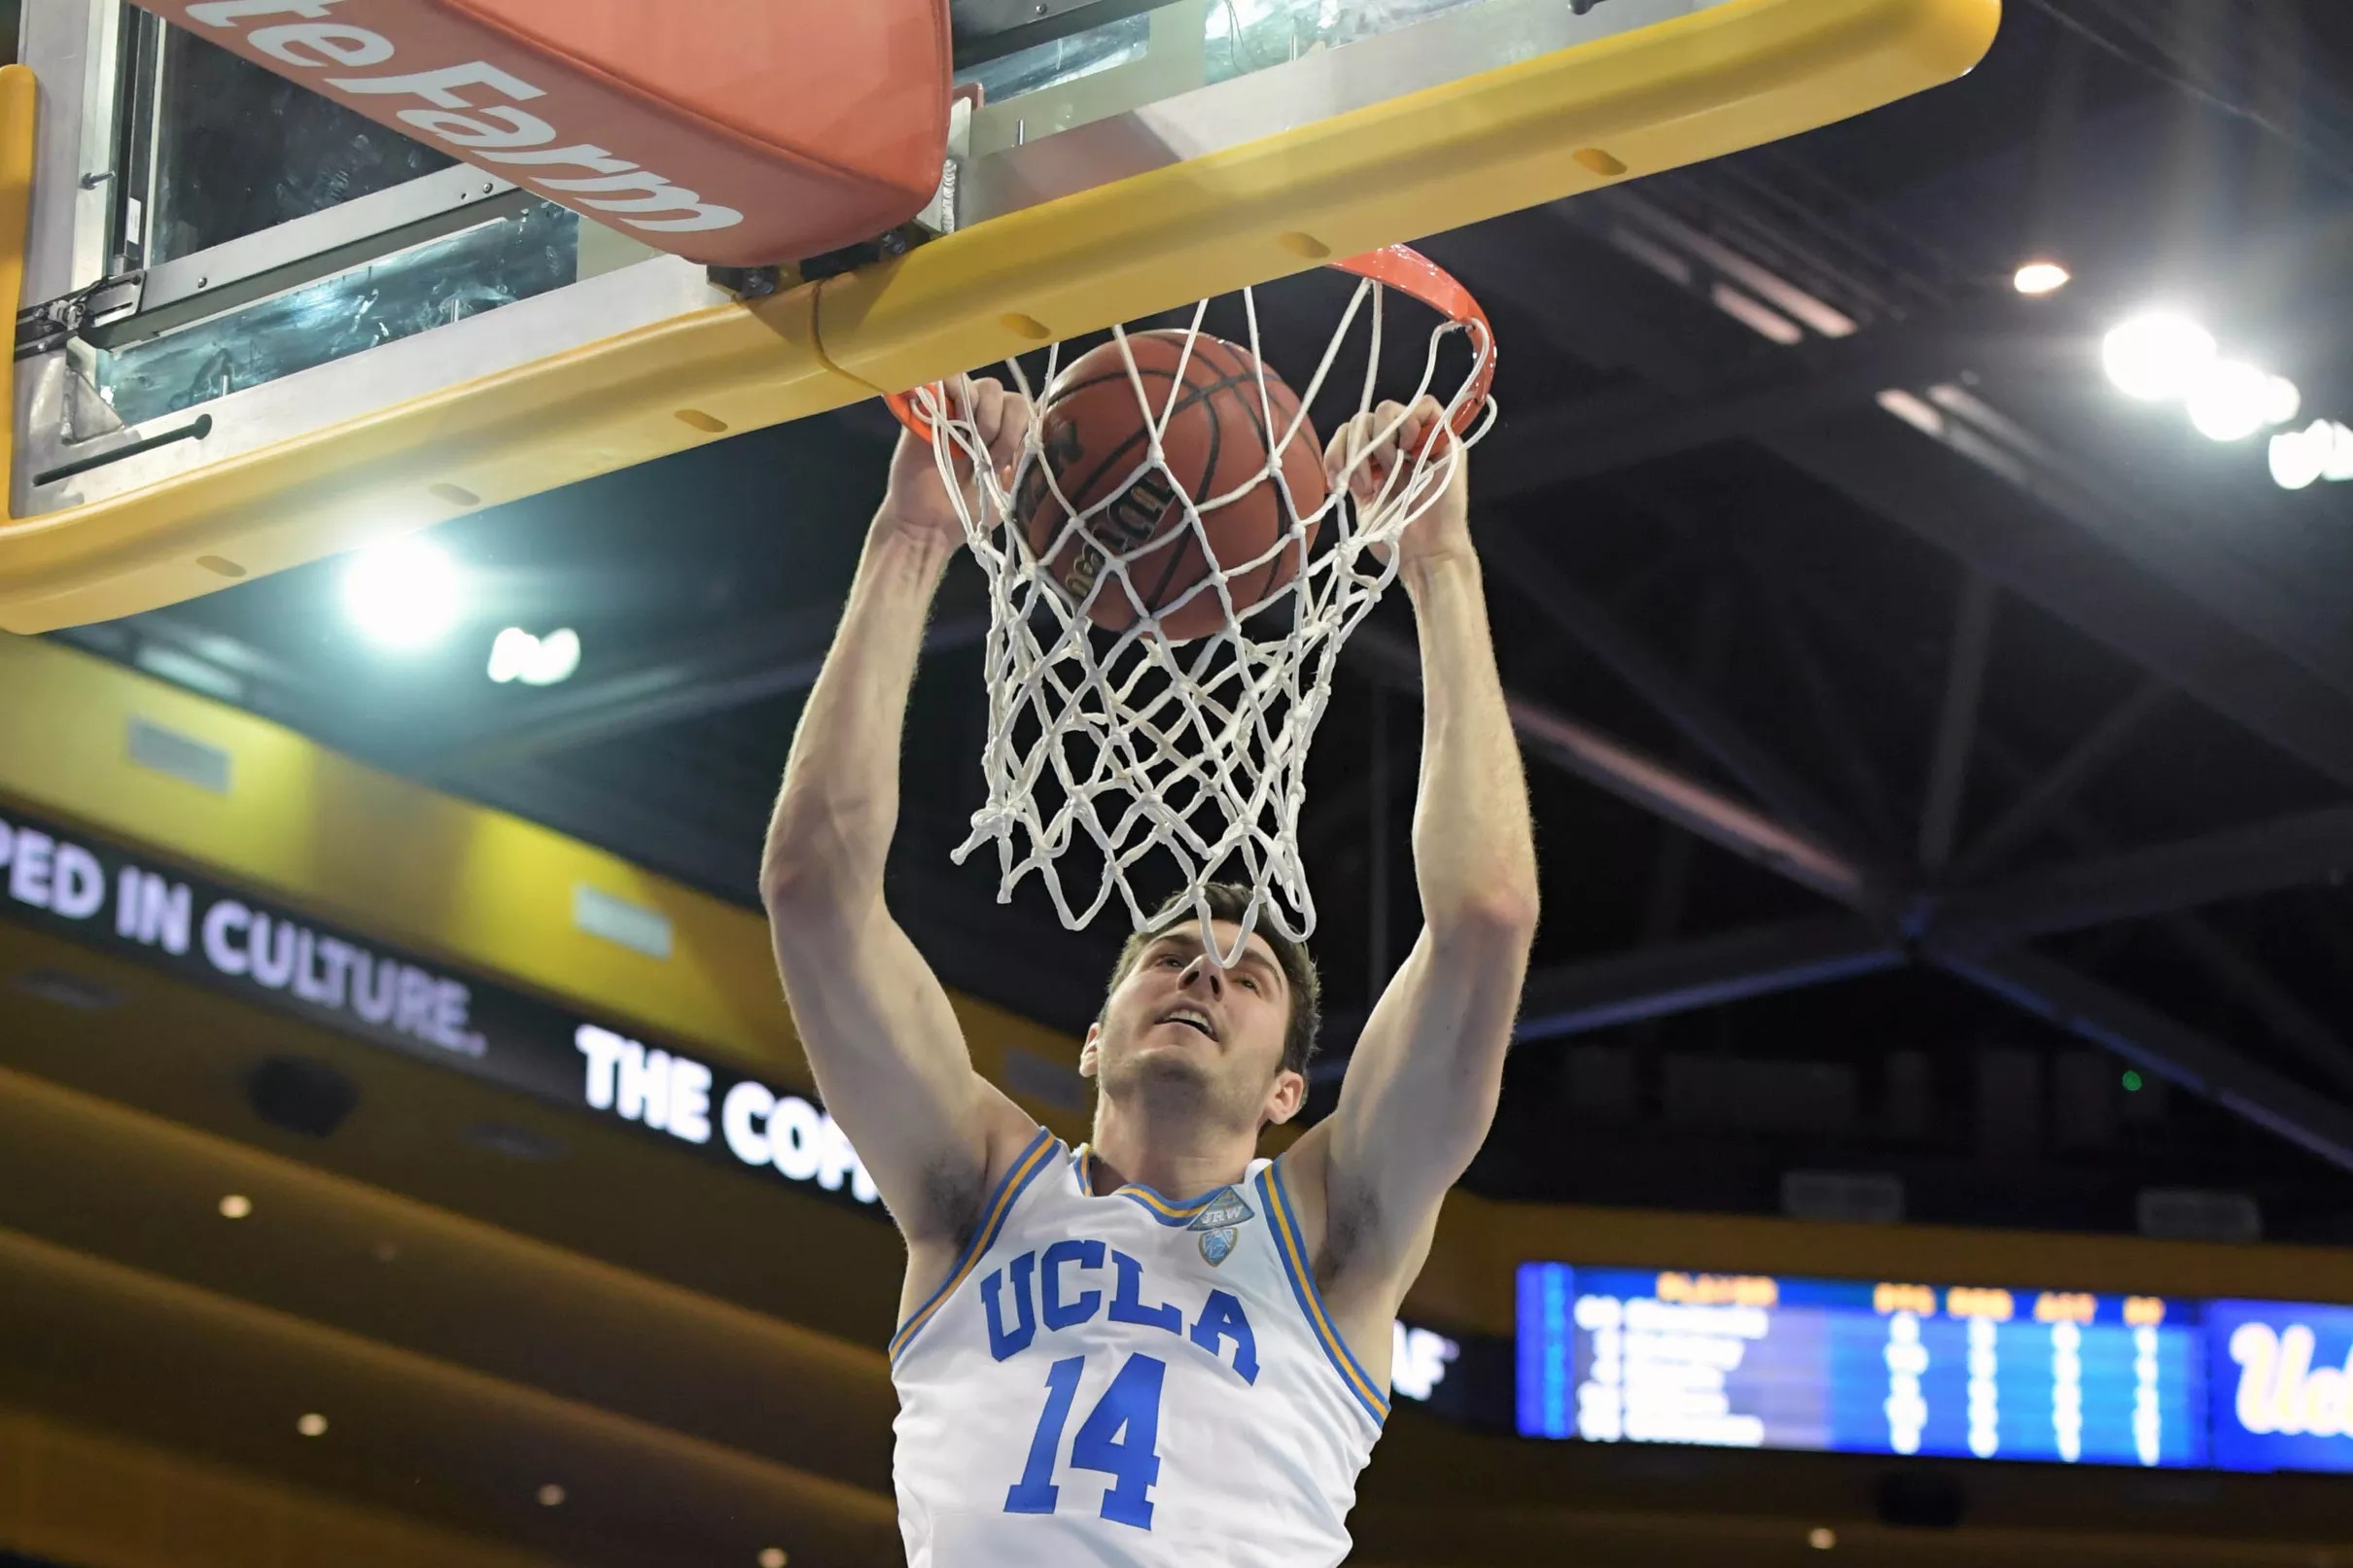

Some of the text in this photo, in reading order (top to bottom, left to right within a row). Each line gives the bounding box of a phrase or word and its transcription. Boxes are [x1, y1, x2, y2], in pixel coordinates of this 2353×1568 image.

[115, 864, 193, 956] IN
[202, 898, 488, 1057] CULTURE.
[574, 1023, 713, 1144] THE
[980, 1239, 1260, 1386] UCLA
[1002, 1352, 1166, 1531] 14
